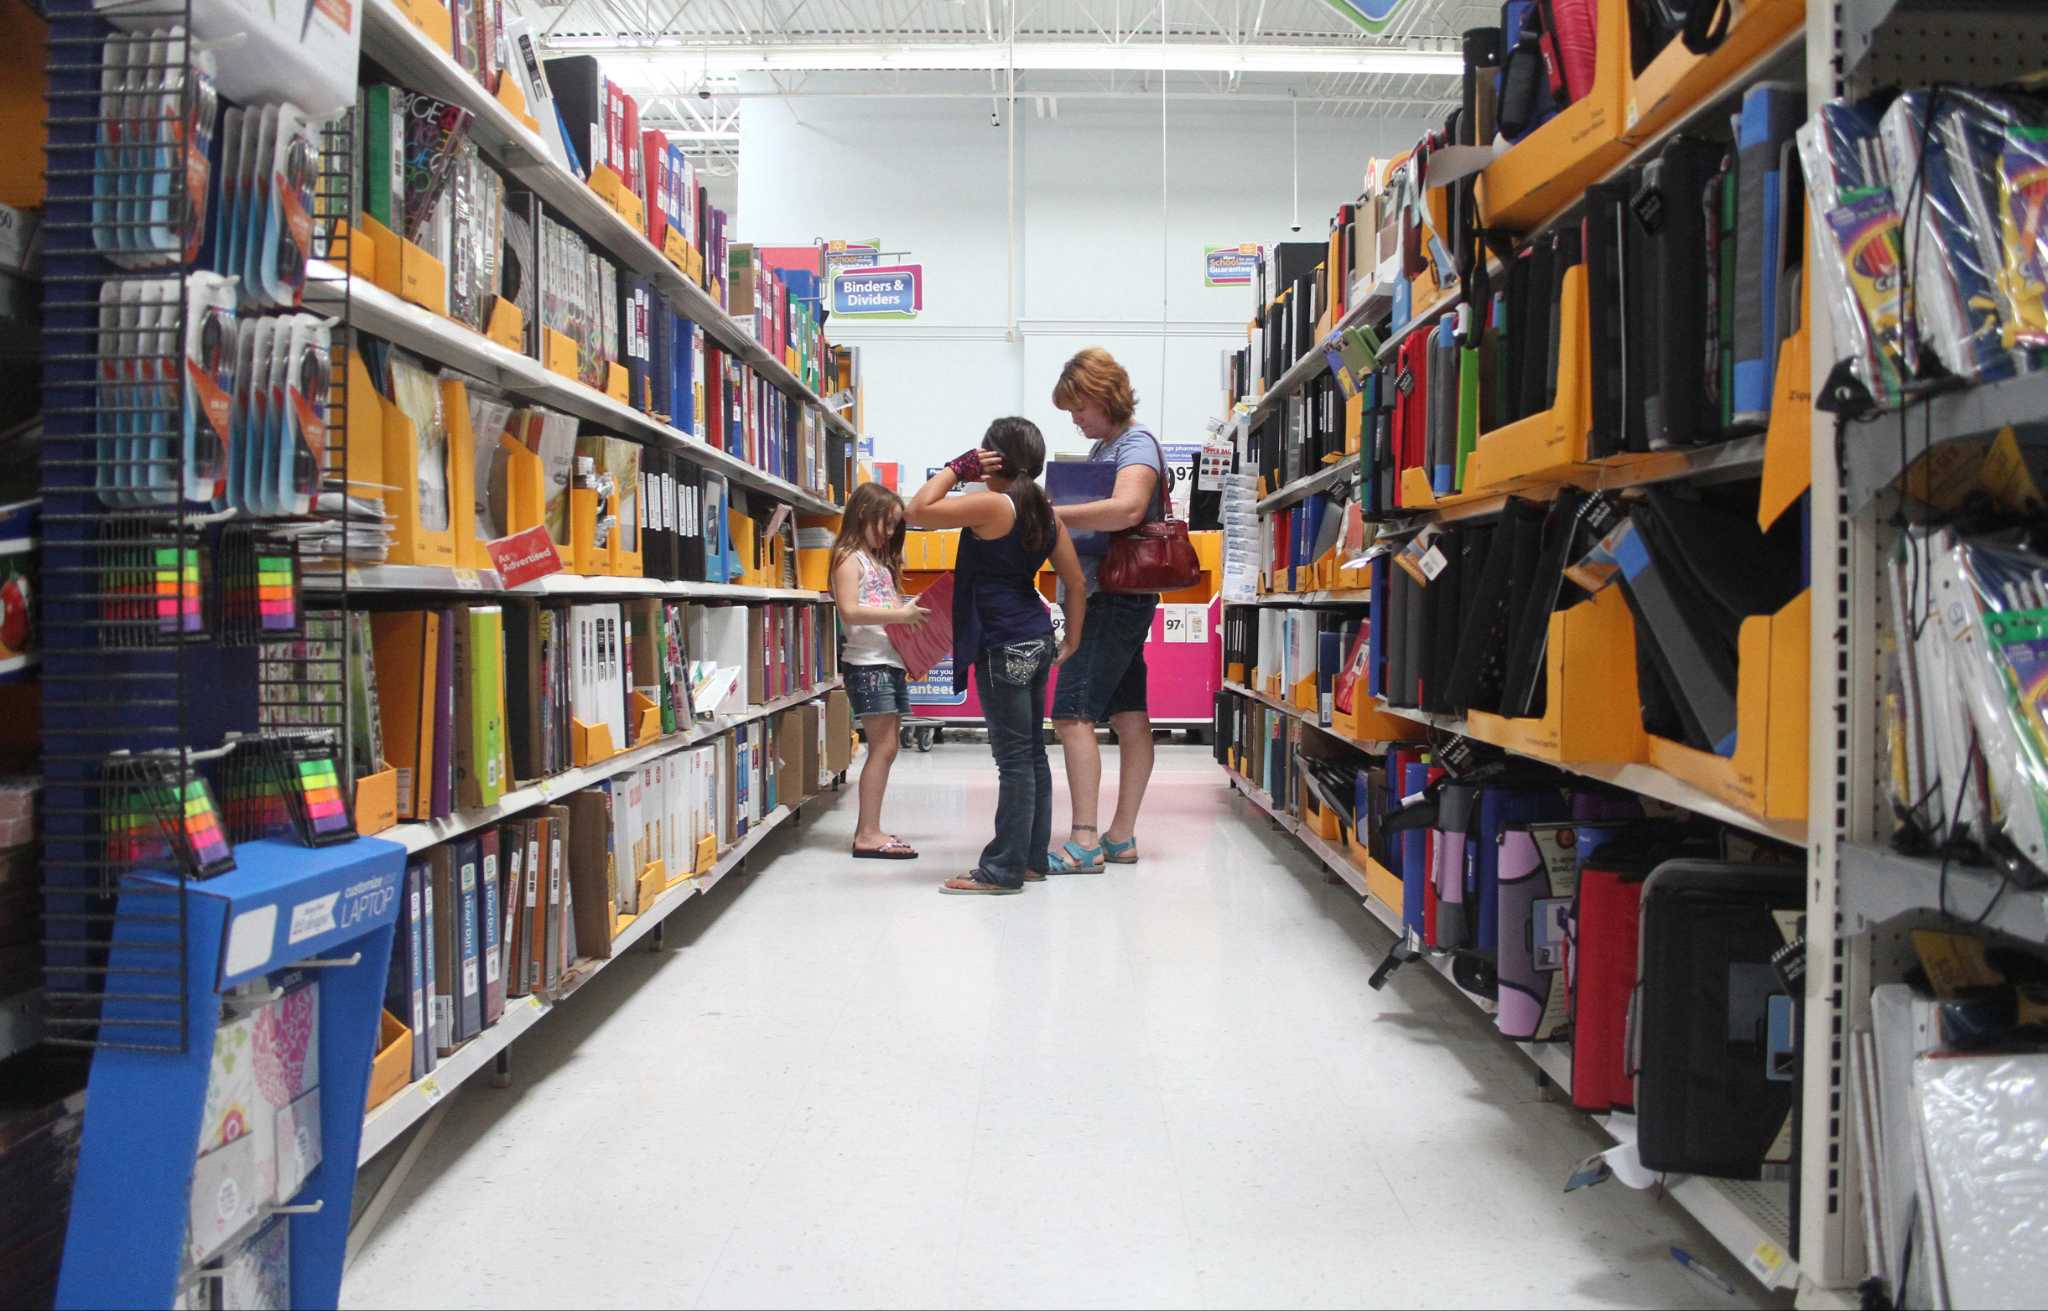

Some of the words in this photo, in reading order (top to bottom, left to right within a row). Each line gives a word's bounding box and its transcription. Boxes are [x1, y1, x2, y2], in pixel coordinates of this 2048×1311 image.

[843, 280, 892, 293] Binders
[894, 279, 904, 291] &
[847, 294, 900, 306] Dividers
[503, 547, 552, 572] Advertised
[341, 886, 396, 929] LAPTOP
